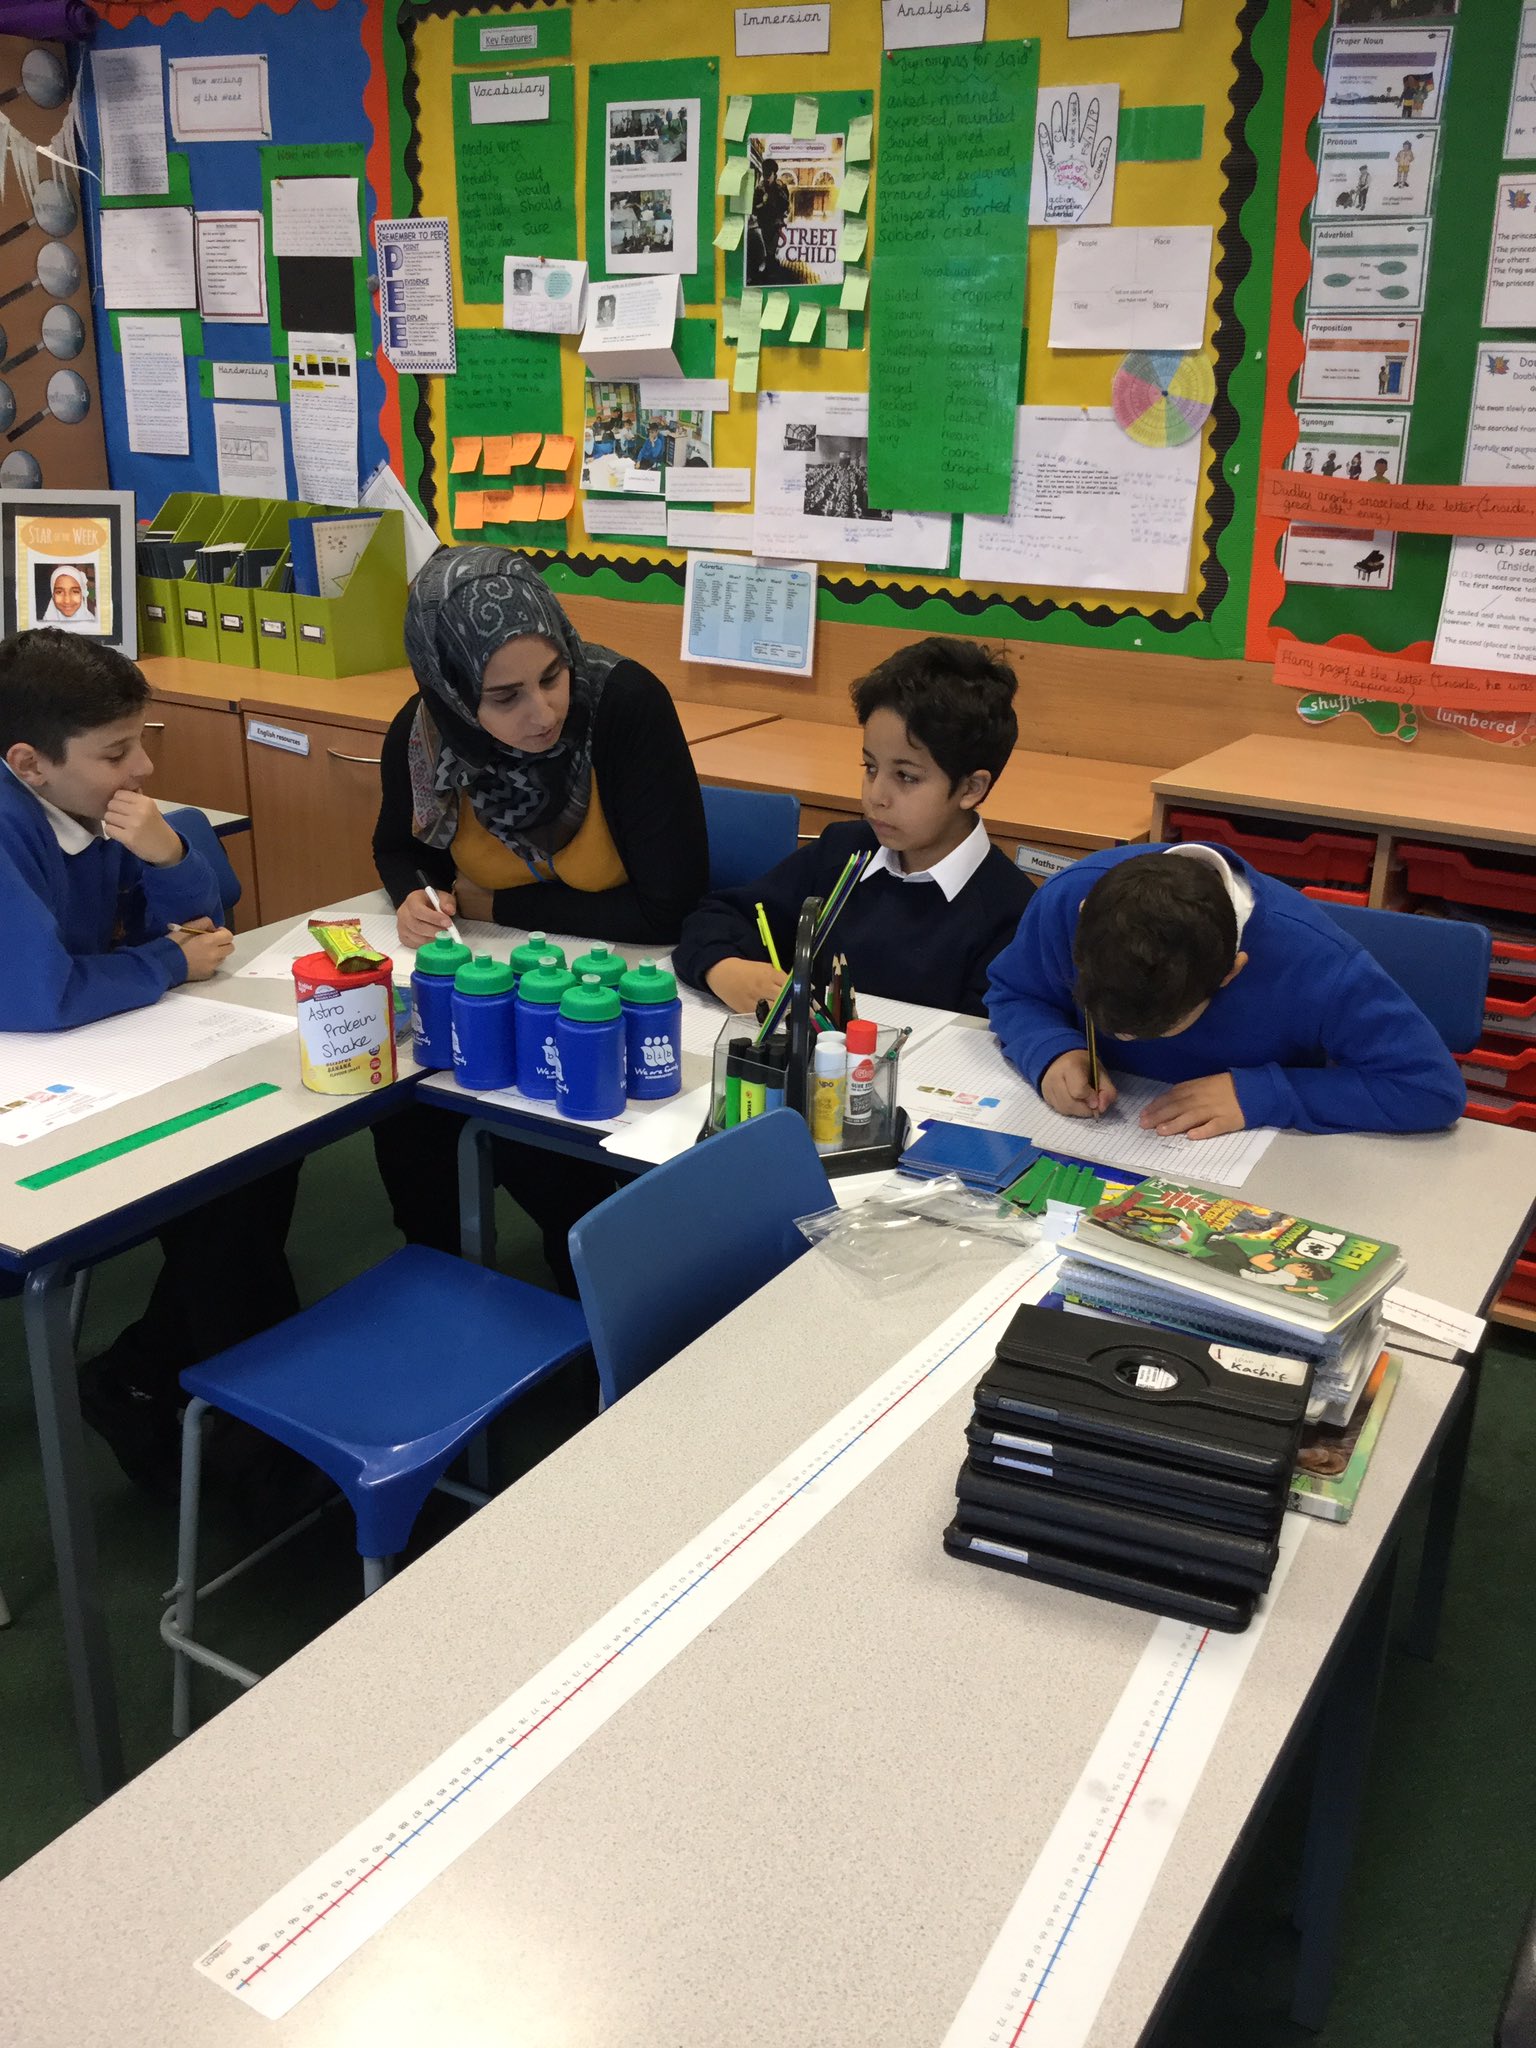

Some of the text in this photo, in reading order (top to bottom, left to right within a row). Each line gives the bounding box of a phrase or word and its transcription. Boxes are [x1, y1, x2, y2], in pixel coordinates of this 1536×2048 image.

[742, 12, 821, 26] Immersion
[897, 2, 970, 19] Analysis
[486, 34, 532, 46] Key Features
[1336, 37, 1383, 46] Proper Noun
[473, 83, 545, 97] Vocabulary
[382, 231, 416, 240] REMEMBER
[420, 231, 428, 239] TO
[778, 227, 838, 248] STREET
[1153, 238, 1171, 246] Place
[384, 244, 403, 277] P
[786, 247, 836, 263] CHILD
[404, 278, 429, 286] EVIDENCE
[387, 280, 406, 312] E
[389, 316, 408, 348] E
[218, 365, 270, 379] Handwriting
[28, 526, 98, 546] STAR WEEK
[1436, 707, 1516, 734] lumbered
[256, 728, 300, 746] English resources
[1031, 857, 1056, 870] Maths
[308, 1003, 344, 1021] Astro
[322, 1035, 372, 1058] Shake
[1296, 1230, 1346, 1260] 10
[1330, 1240, 1380, 1271] BEN
